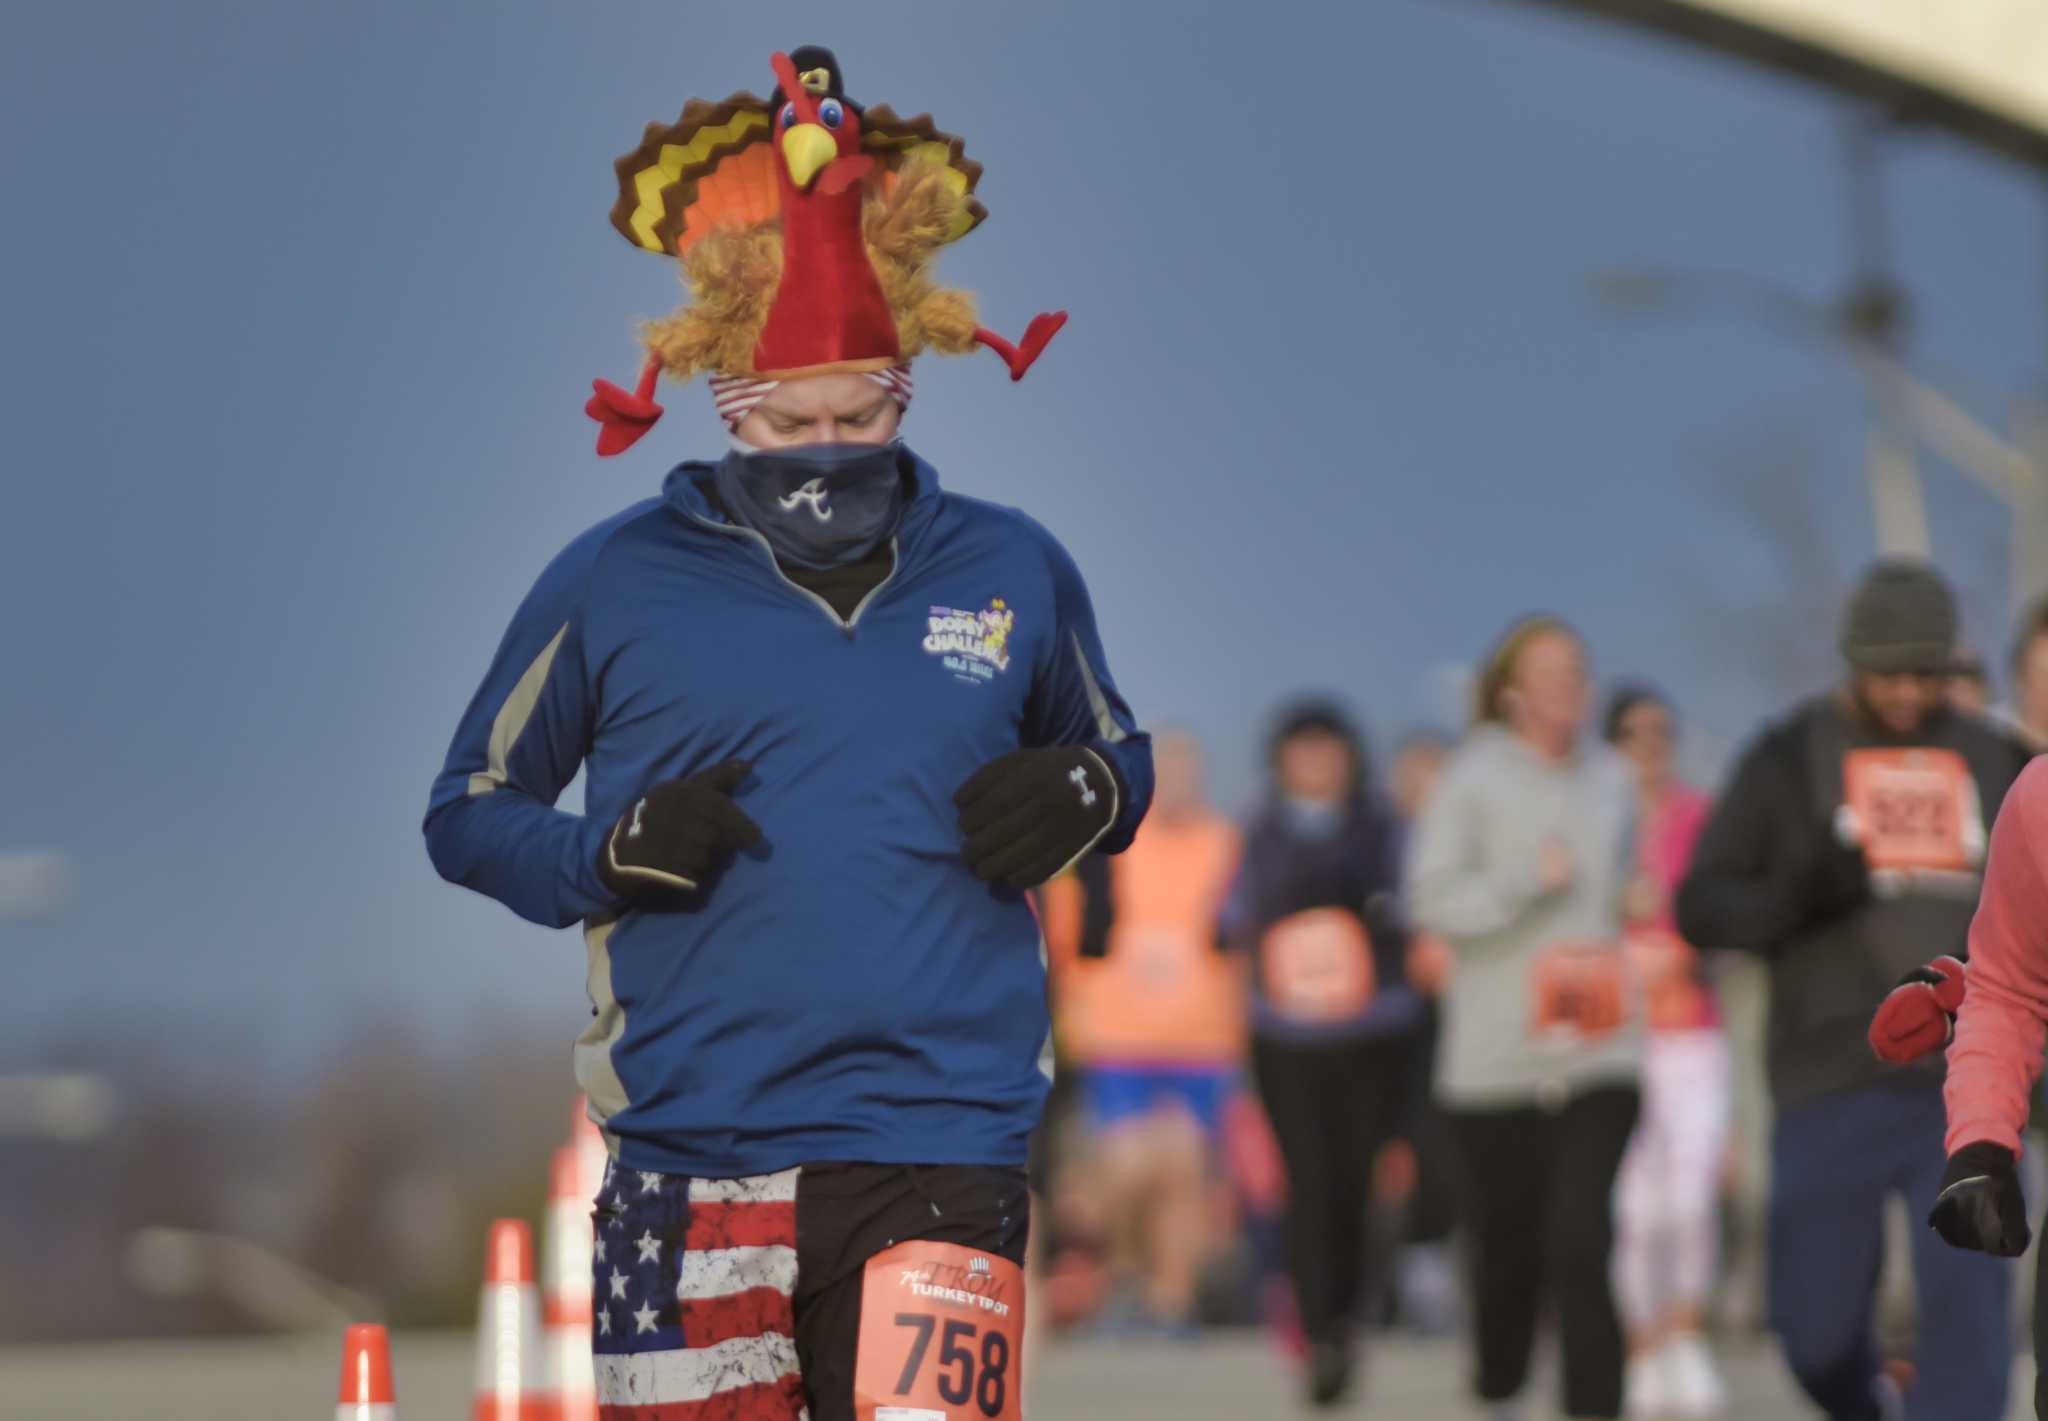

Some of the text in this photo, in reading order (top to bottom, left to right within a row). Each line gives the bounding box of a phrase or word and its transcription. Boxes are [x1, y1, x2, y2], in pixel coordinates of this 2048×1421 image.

[911, 1282, 1009, 1316] TURKEY TROT
[893, 1312, 1009, 1418] 758
